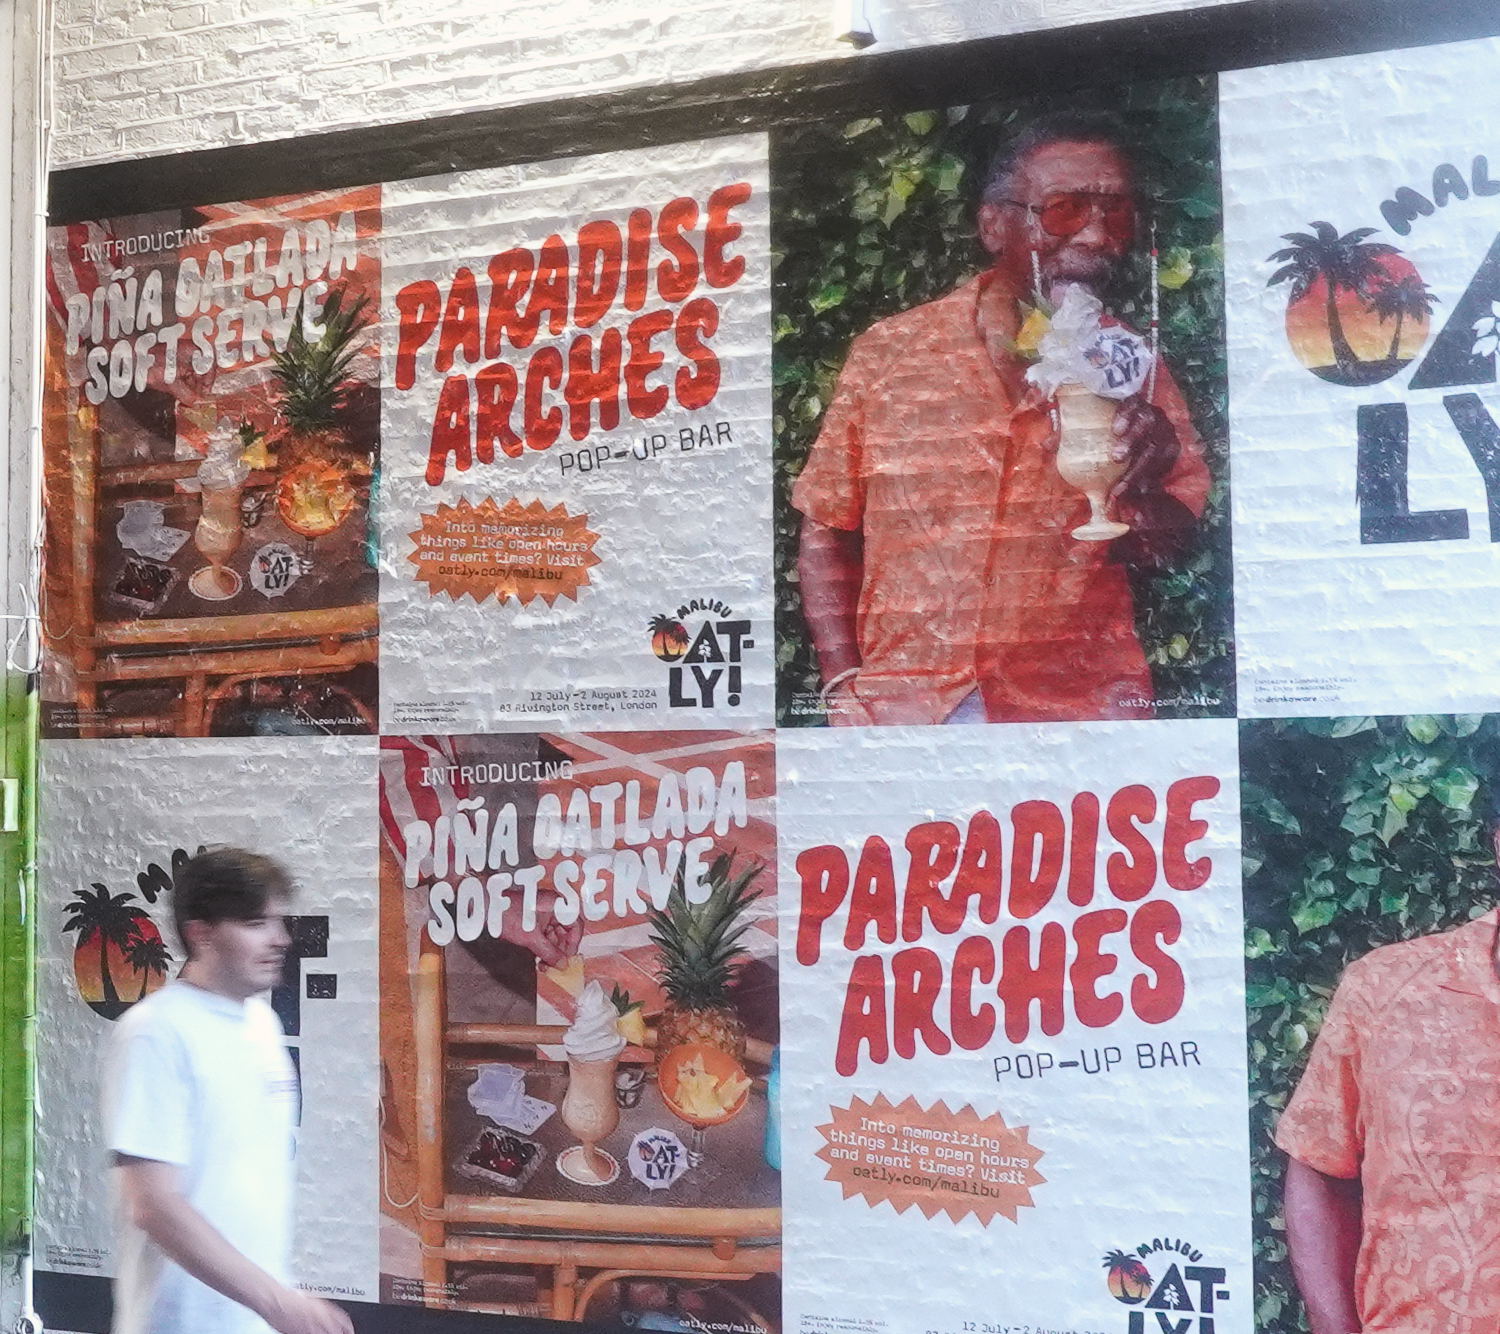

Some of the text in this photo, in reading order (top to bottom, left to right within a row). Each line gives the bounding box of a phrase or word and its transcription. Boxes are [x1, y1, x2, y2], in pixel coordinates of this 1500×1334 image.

[81, 227, 211, 263] INTRODUCING
[66, 210, 358, 356] PIÑA OATLADA
[395, 182, 752, 391] PARADISE
[85, 280, 329, 405] SOFT SERVE
[425, 297, 723, 488] ARCHES
[559, 421, 733, 476] POP-UP BAR
[420, 535, 588, 554] things like open hours
[445, 520, 564, 538] Into memorizing
[420, 550, 585, 567] and event times? Visit
[439, 565, 563, 582] oatly.com/malibu
[676, 598, 733, 620] MALIBU
[530, 691, 545, 701] 12
[591, 689, 628, 702] August
[632, 689, 657, 699] 2024
[669, 664, 742, 709] LY!
[515, 703, 570, 715] Rivington
[573, 701, 616, 713] Street,
[620, 699, 658, 711] London
[420, 759, 574, 788] INTRODUCING
[403, 760, 748, 889] PIÑA OATLADA
[795, 775, 1221, 967] PARADISE
[427, 836, 715, 946] SOFT SERVE
[833, 900, 1186, 1078] ARCHES
[993, 1041, 1202, 1083] POP-UP BAR
[830, 1128, 1030, 1169] things like open hours
[860, 1117, 1001, 1154] Into memorizing
[830, 1147, 1027, 1185] and event times? Visit
[852, 1166, 1001, 1199] oatly.com/malibu
[1136, 1237, 1204, 1263] MALIBU
[295, 1282, 366, 1296] tly.com/malibu
[678, 1318, 768, 1334] oatly.com/malibu
[962, 1321, 977, 1332] 12
